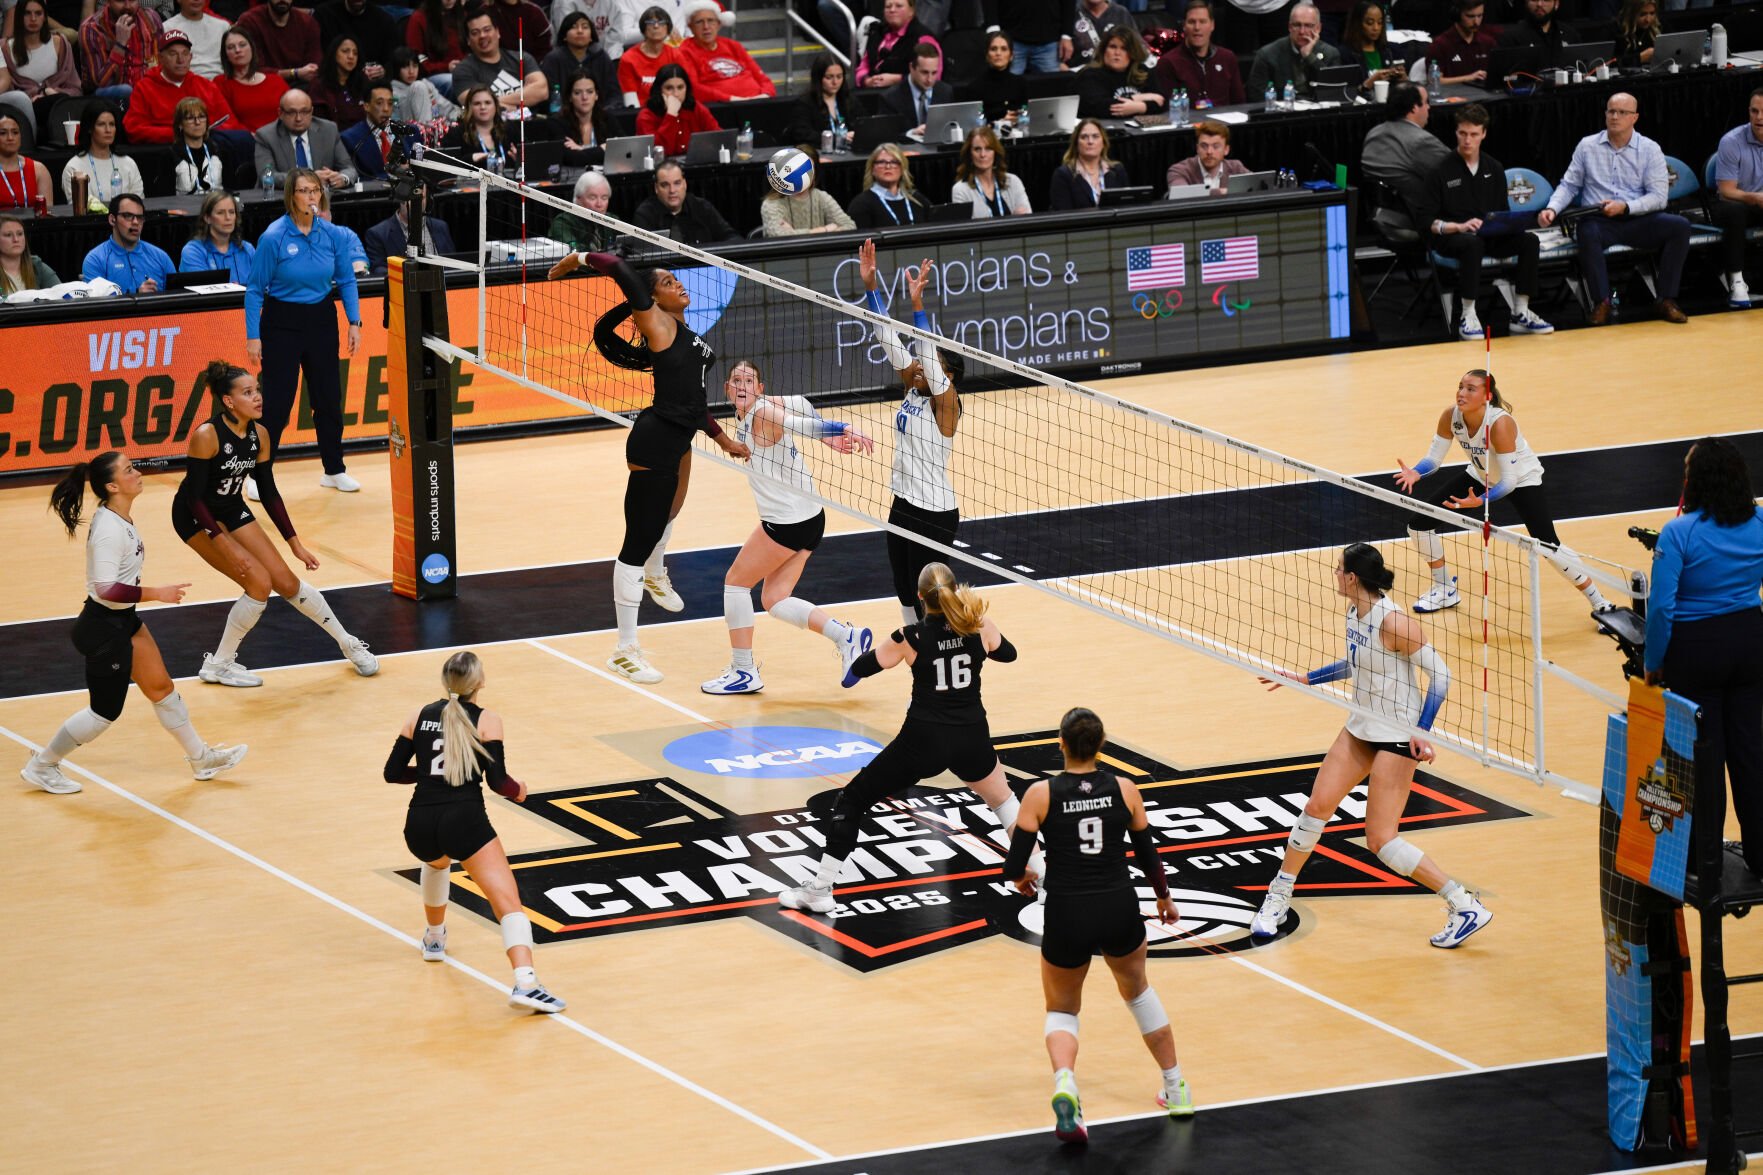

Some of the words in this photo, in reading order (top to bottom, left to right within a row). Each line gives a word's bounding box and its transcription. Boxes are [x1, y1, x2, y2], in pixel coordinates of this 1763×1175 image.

[769, 167, 790, 189] molten
[833, 247, 1053, 312] Oympians
[1063, 260, 1079, 285] &
[88, 326, 181, 373] VISIT
[1018, 353, 1052, 366] MADE
[1057, 350, 1089, 363] HERE
[217, 476, 243, 496] 37
[427, 460, 440, 496] sports
[429, 497, 441, 541] imports
[424, 566, 449, 578] NCAA
[937, 637, 964, 651] WAAK
[1350, 643, 1357, 668] 7
[932, 653, 972, 691] 16
[704, 741, 884, 773] NCAA
[1062, 796, 1113, 813] LEDNICKY
[1637, 788, 1682, 812] CHAMPIONSHIP
[772, 811, 821, 825] DI
[1078, 816, 1103, 855] 9
[825, 890, 952, 919] 2025
[1186, 845, 1287, 870] CITY
